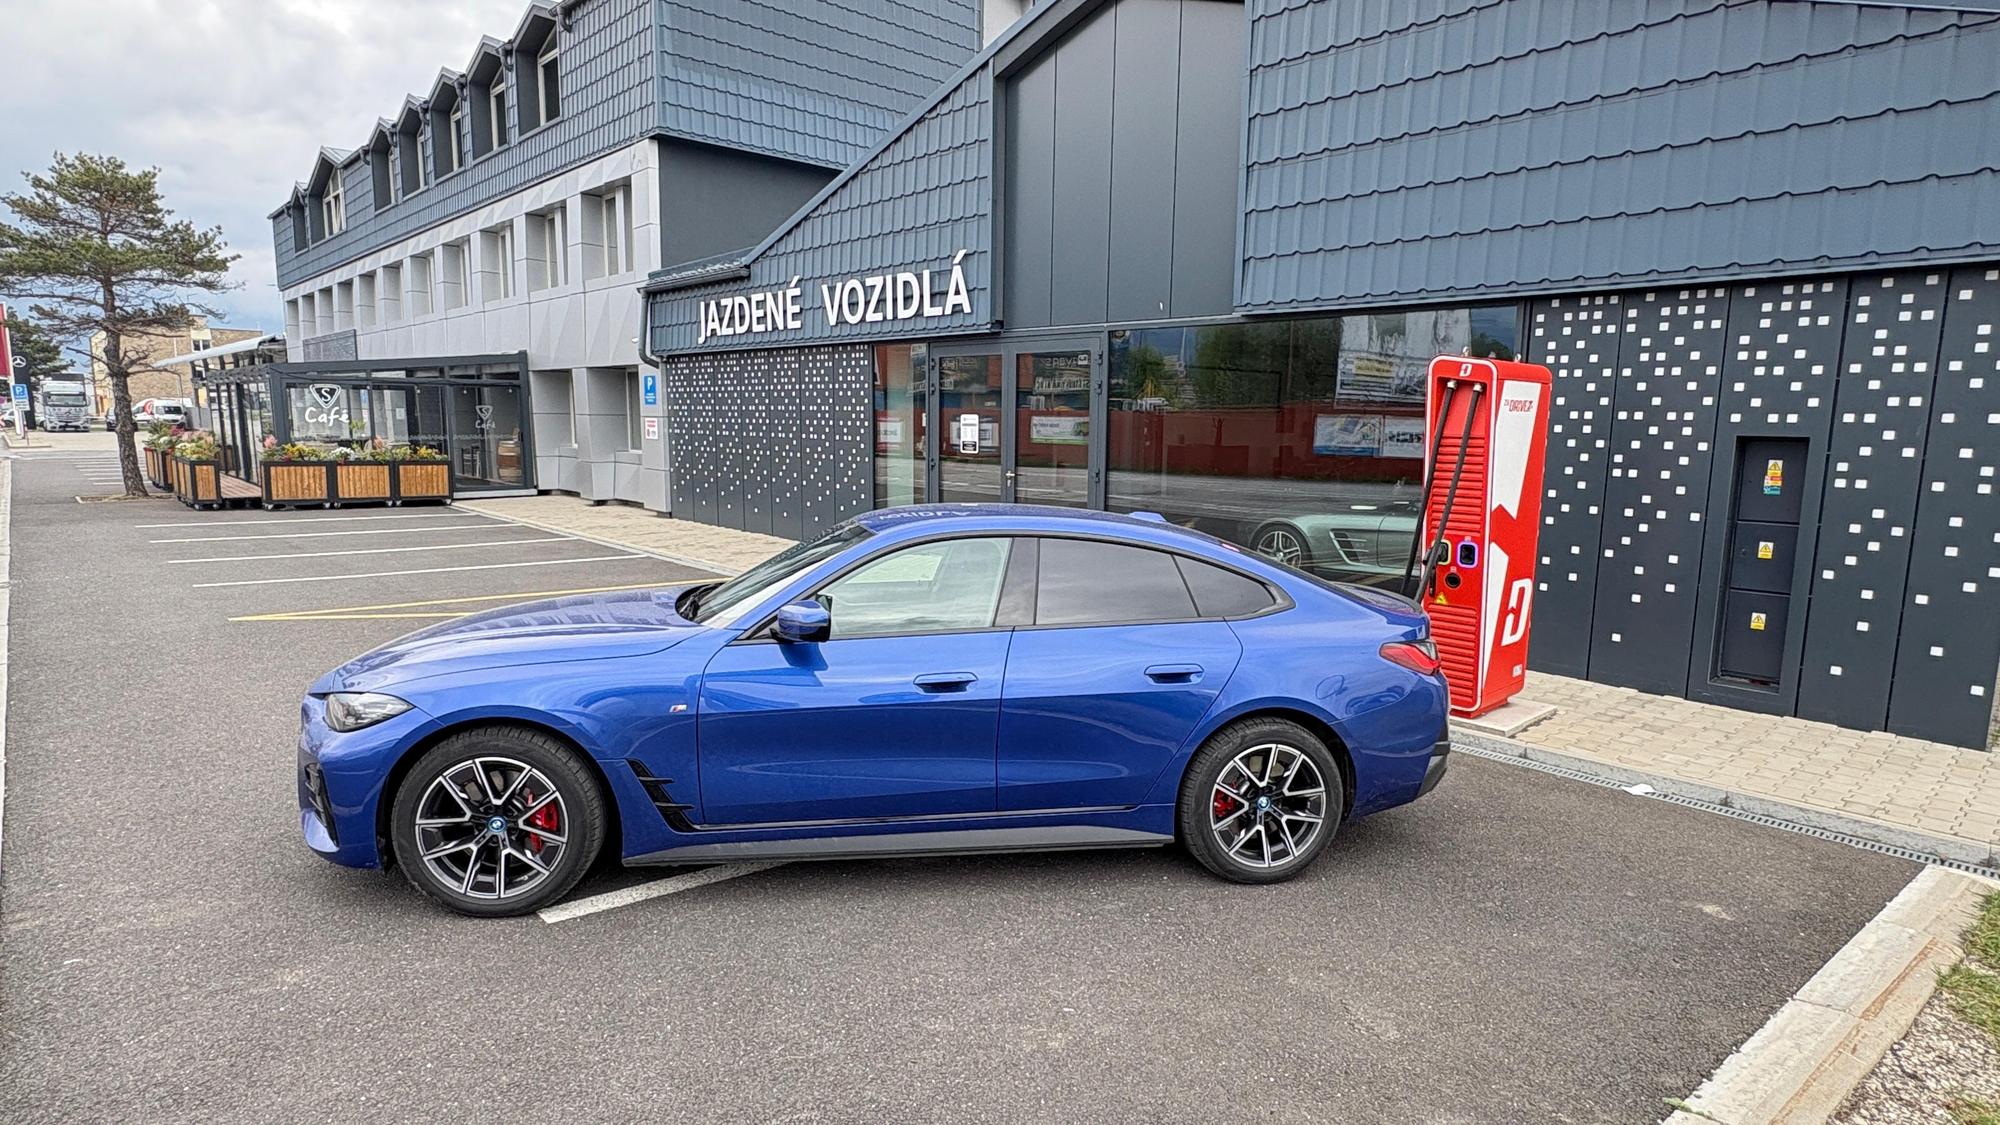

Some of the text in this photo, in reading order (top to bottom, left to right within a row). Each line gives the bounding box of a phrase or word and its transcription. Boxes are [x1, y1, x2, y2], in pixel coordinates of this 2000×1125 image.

[698, 249, 972, 344] JAZDENÉ VOZIDLÁ
[647, 376, 653, 390] P
[321, 388, 331, 401] S
[305, 407, 349, 426] Café
